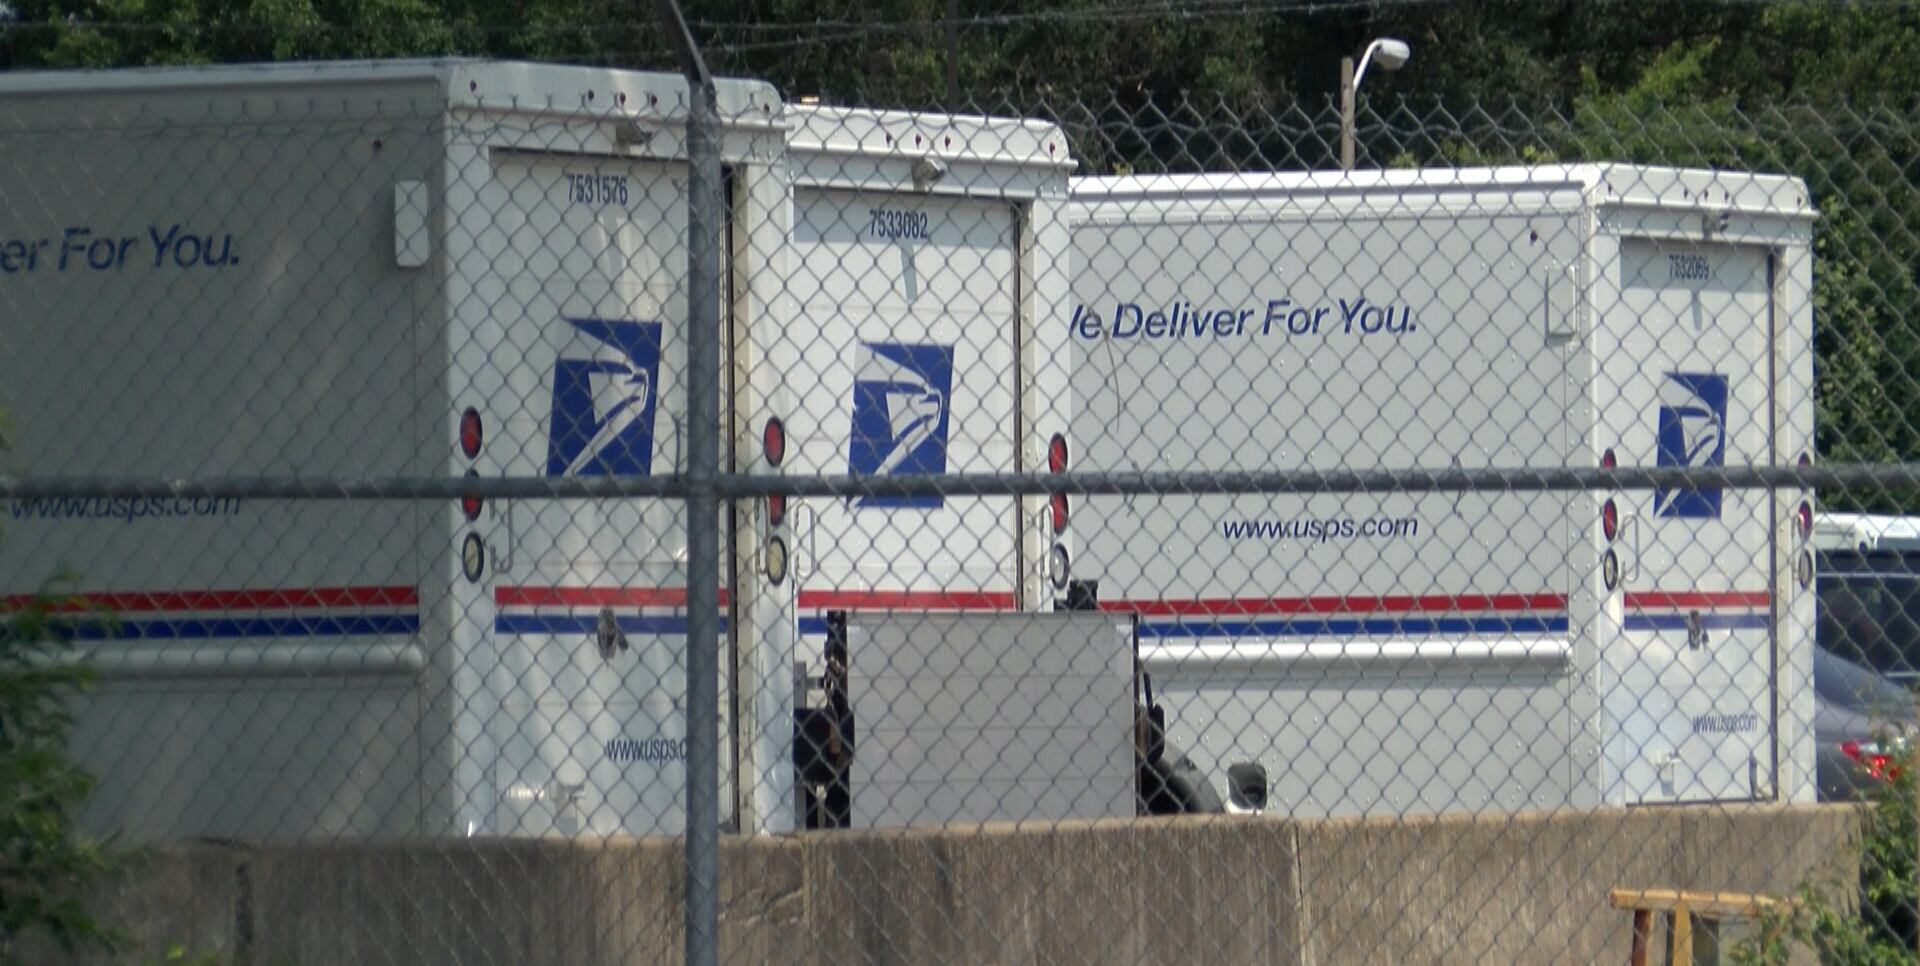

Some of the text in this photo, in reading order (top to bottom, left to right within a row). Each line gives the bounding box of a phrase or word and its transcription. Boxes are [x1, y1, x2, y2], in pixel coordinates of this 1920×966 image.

[567, 174, 628, 206] 7531576
[869, 209, 929, 239] 7533082
[57, 227, 138, 272] For
[150, 224, 240, 268] You.
[1667, 254, 1711, 282] 7532069
[1111, 301, 1255, 339] Deliver
[1262, 299, 1330, 336] For
[1338, 298, 1417, 334] You.
[1223, 516, 1418, 543] www.usps.com
